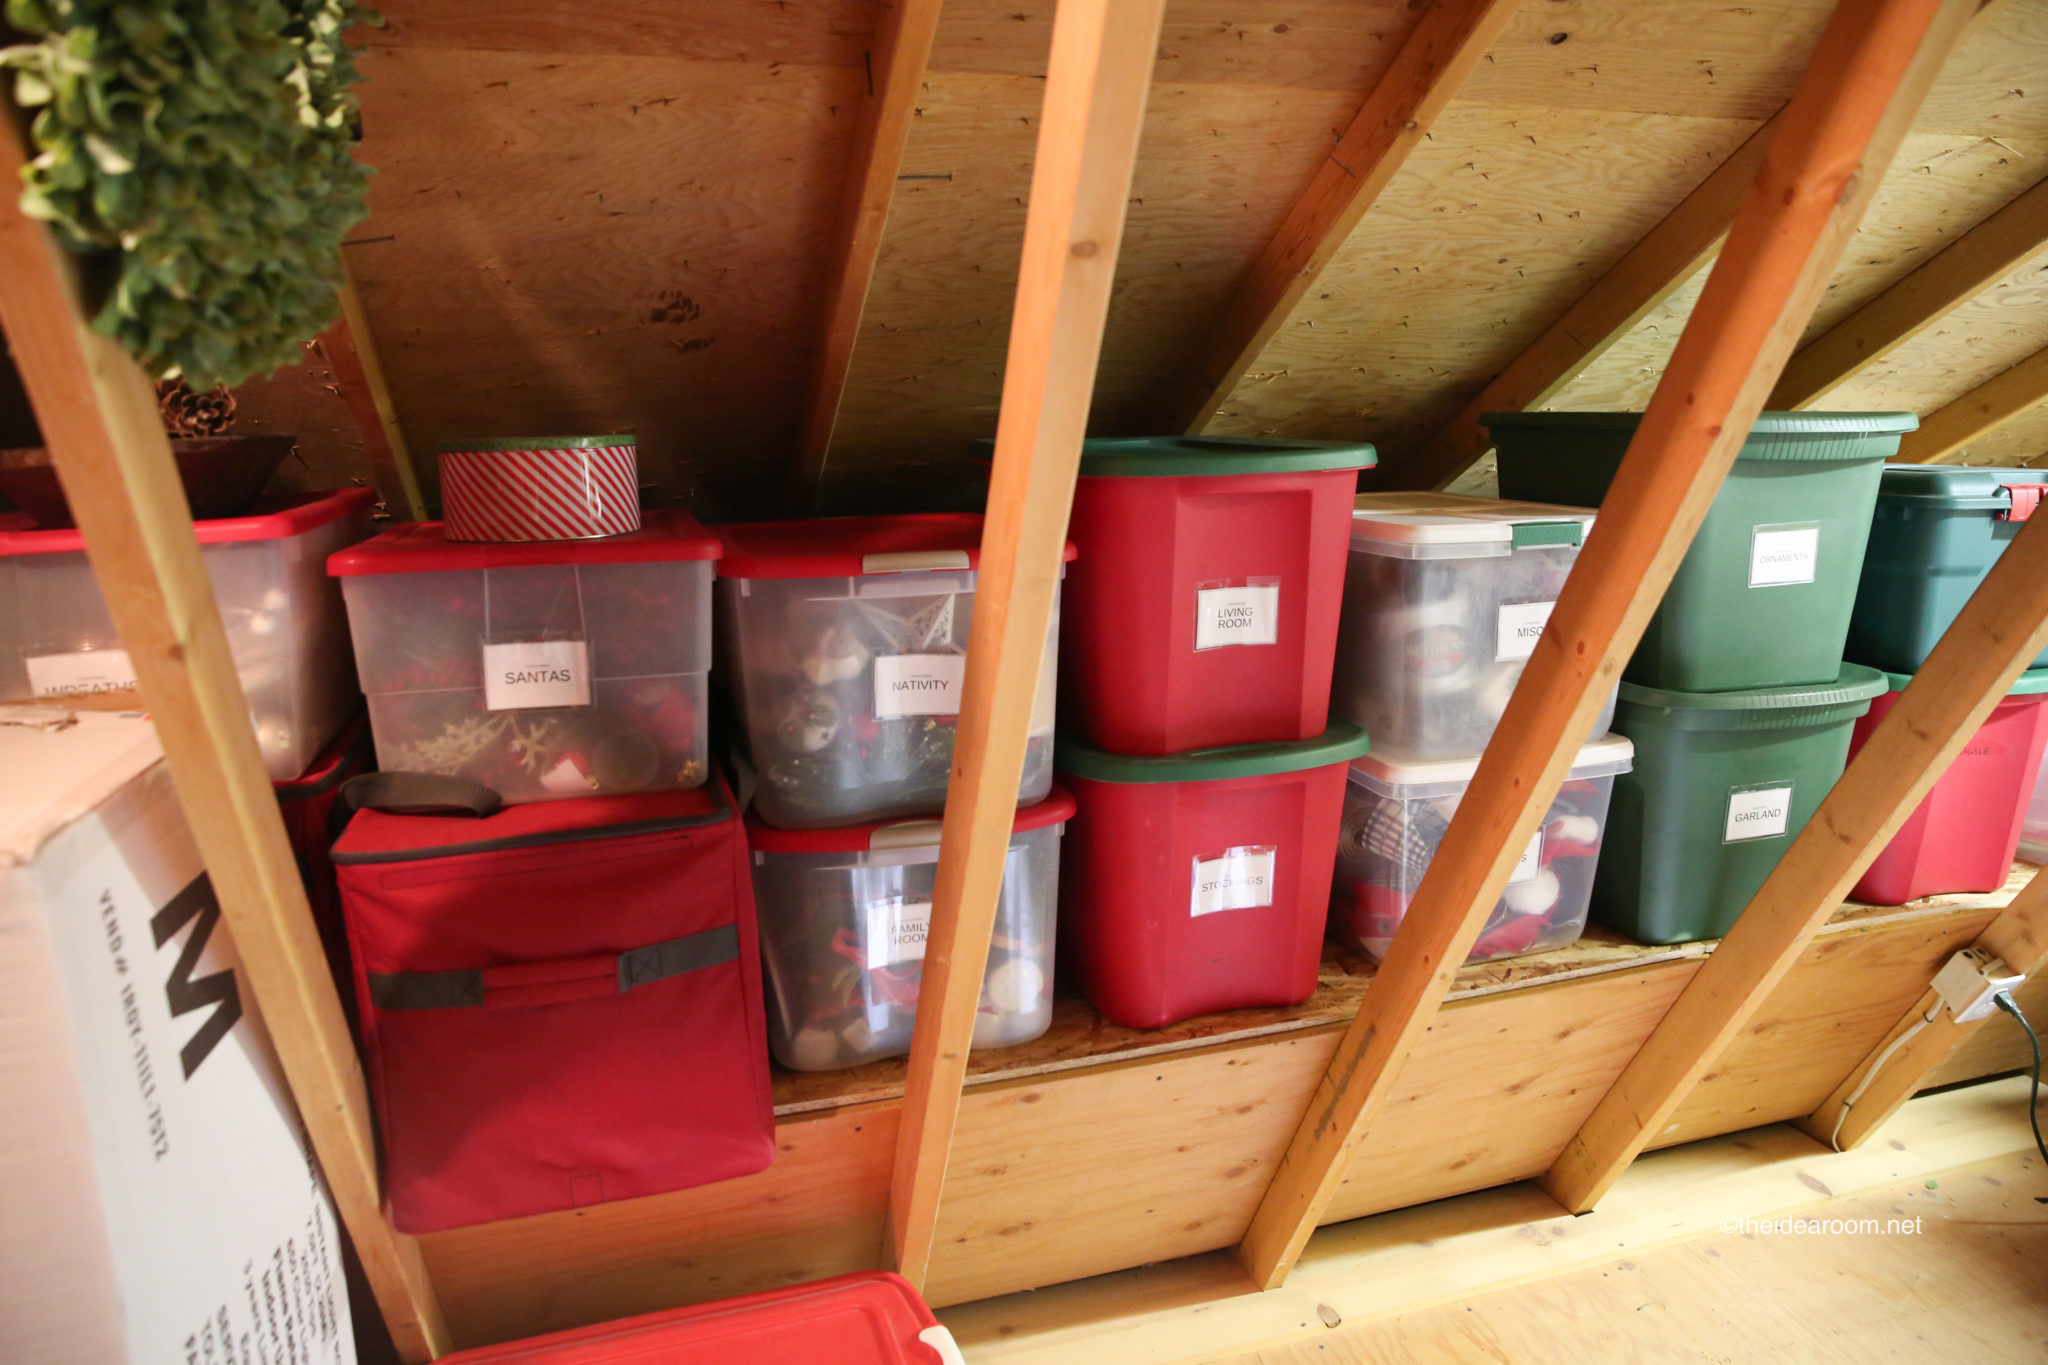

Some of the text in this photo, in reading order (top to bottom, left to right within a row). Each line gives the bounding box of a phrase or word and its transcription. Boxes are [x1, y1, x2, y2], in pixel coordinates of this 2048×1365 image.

[1759, 552, 1809, 564] ORNAMENTS
[1217, 607, 1253, 618] LIVING
[1218, 618, 1252, 629] ROOM
[505, 669, 571, 685] SANTAS
[892, 680, 949, 691] NATIVITY
[1735, 808, 1781, 822] GARLAND
